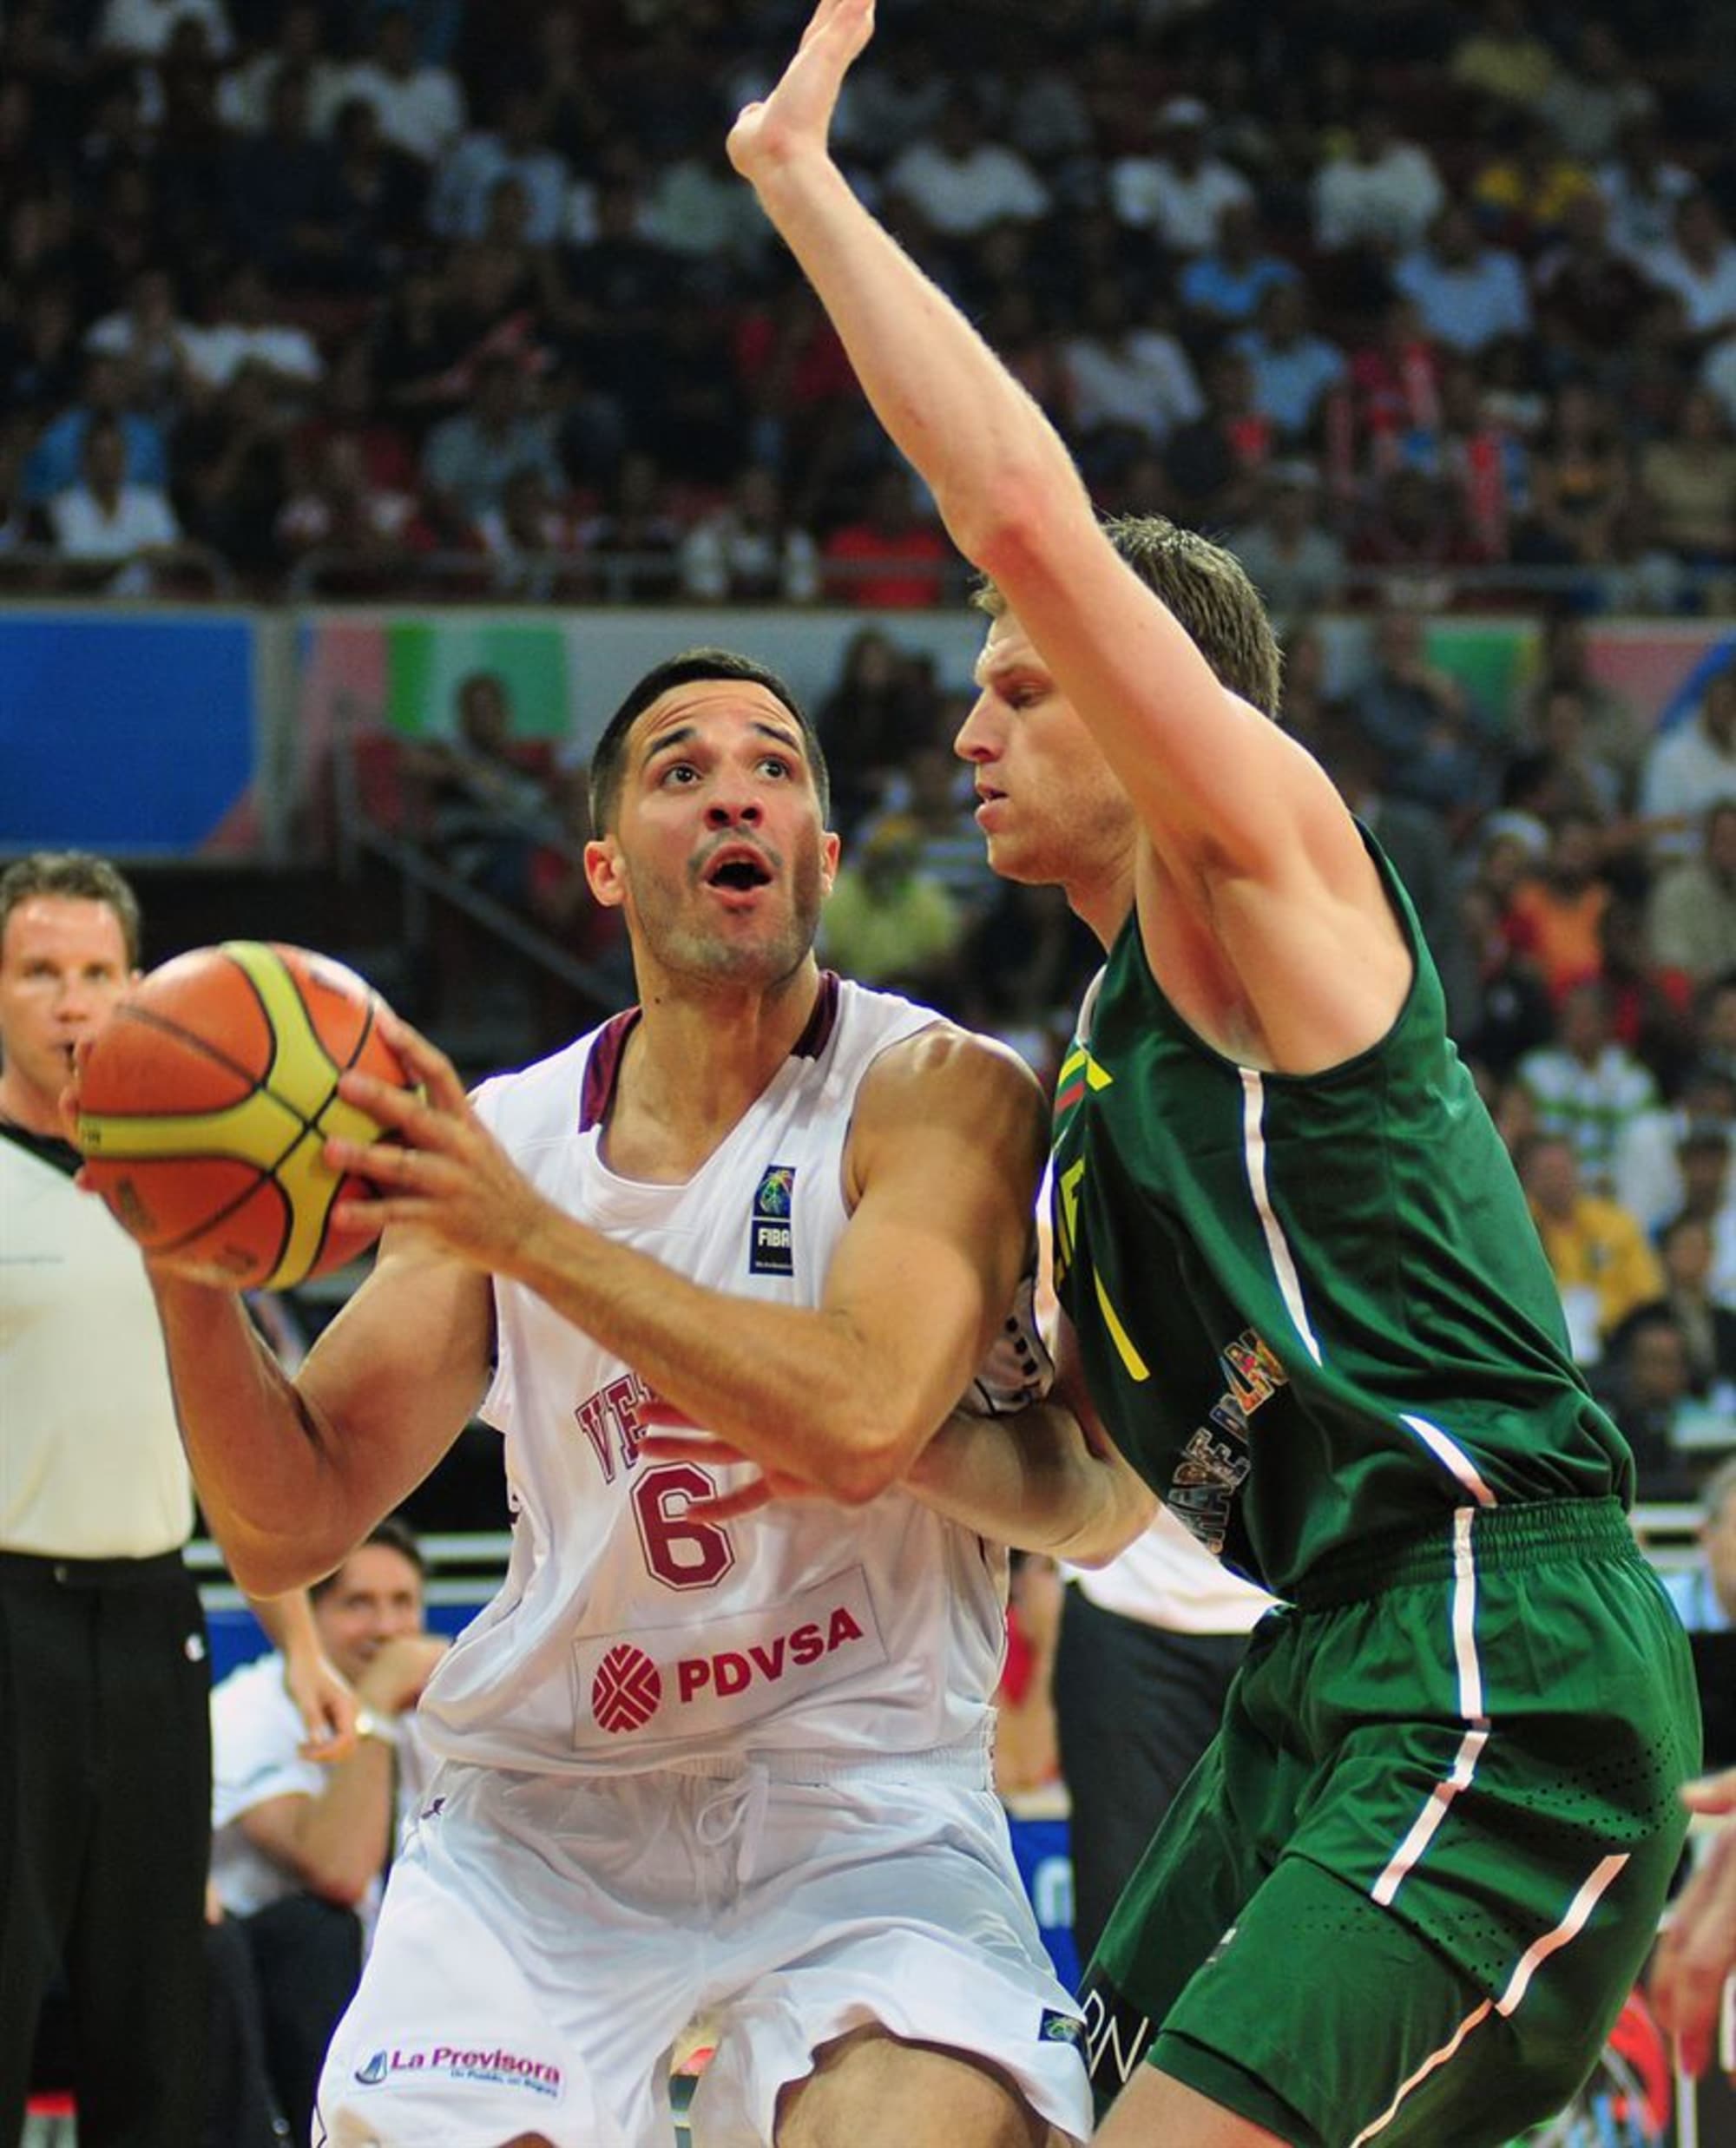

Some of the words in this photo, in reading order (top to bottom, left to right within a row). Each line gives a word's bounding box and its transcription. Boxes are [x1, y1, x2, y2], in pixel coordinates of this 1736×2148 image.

[758, 1227, 792, 1248] FIBA
[630, 1460, 735, 1592] 6
[678, 1606, 864, 1703] PDVSA
[391, 2050, 424, 2070] La
[431, 2046, 561, 2084] Previsora
